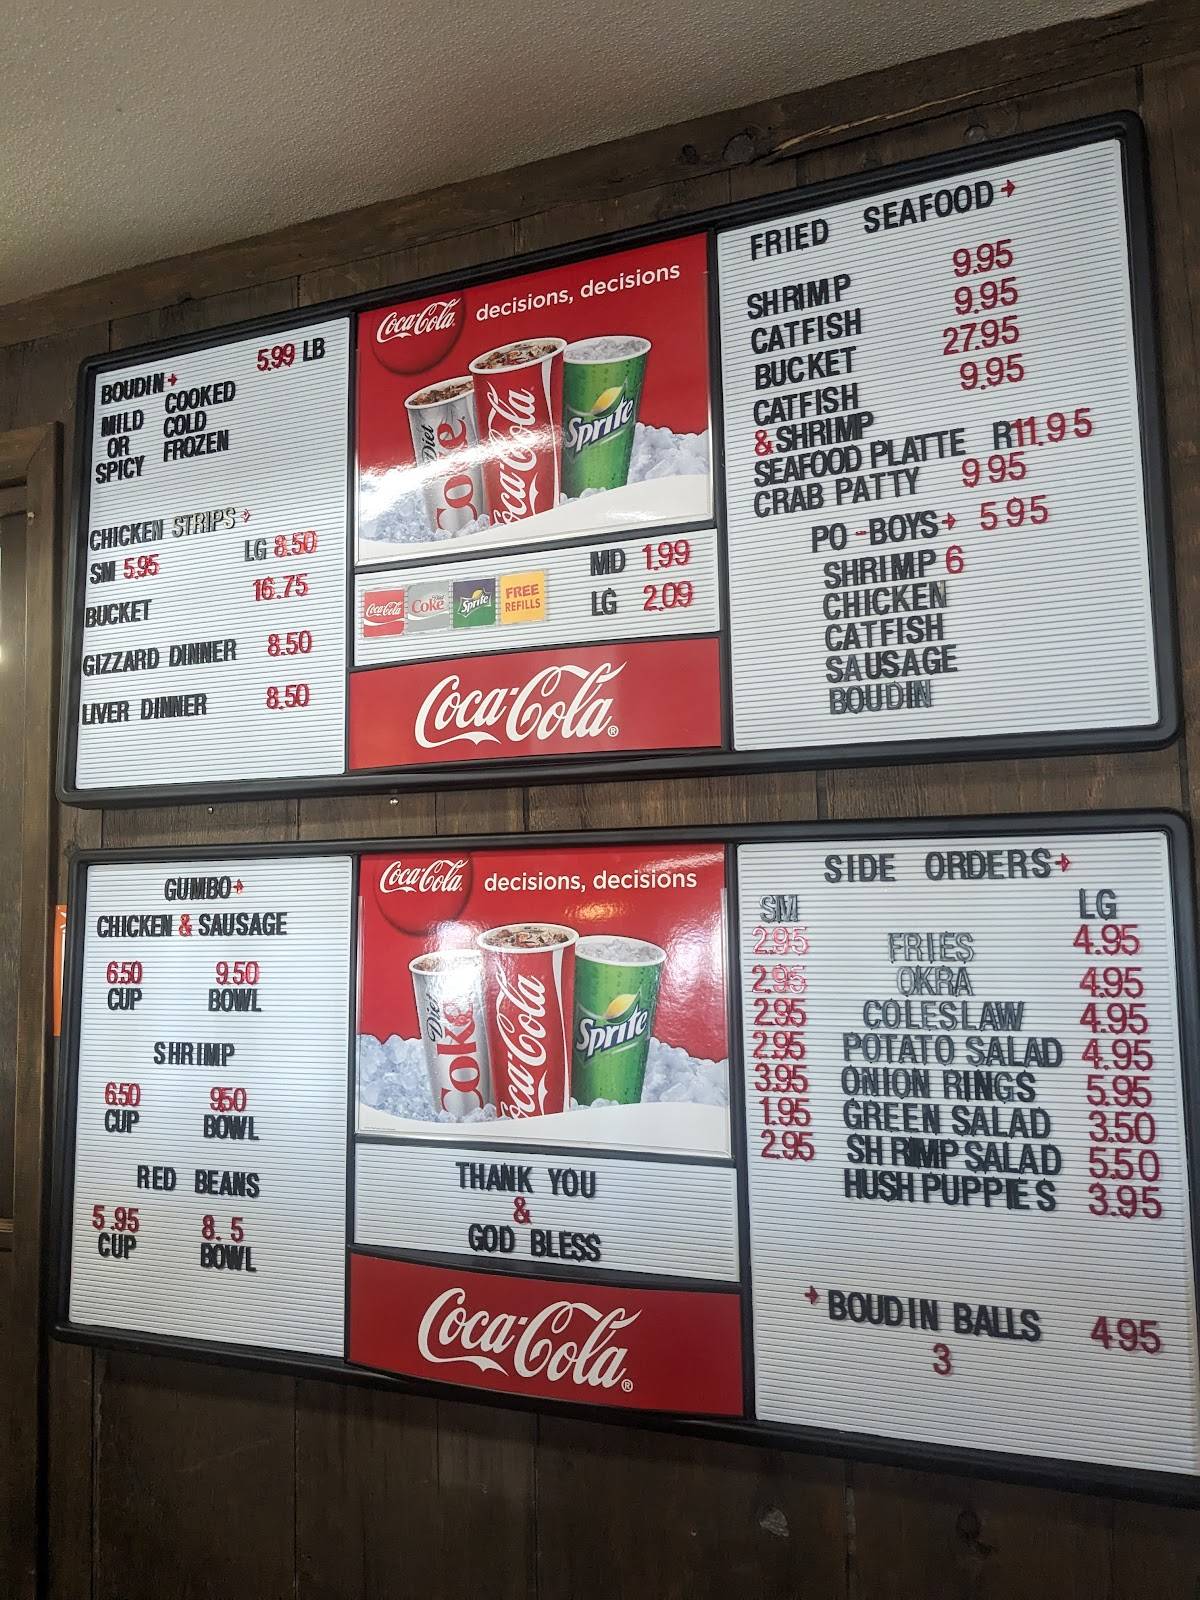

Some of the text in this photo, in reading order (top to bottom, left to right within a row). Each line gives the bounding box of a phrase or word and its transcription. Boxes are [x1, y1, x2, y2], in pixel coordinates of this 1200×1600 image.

[750, 180, 993, 260] FRIED SEAFOOD
[953, 239, 1013, 277] 9.95
[476, 265, 680, 321] decisions, decisions
[747, 273, 851, 320] SHRIMP
[954, 277, 1018, 316] 9.95
[376, 298, 461, 343] Coca-Cola
[751, 308, 861, 354] CATFISH
[942, 315, 1019, 355] 27.95
[257, 337, 325, 371] 5.99 LB
[755, 347, 856, 390] BUCKET
[101, 373, 165, 404] BOUDIN
[959, 353, 1024, 391] 9.95
[165, 381, 236, 413] COOKED
[753, 383, 859, 427] CATFISH
[101, 410, 144, 437] MILD
[164, 411, 206, 438] COLD
[567, 397, 633, 452] Sprite
[107, 436, 130, 459] OR
[164, 430, 229, 462] FROZEN
[96, 456, 145, 483] SPICY
[754, 444, 861, 487] SEAFOOD
[754, 467, 919, 517] CRAB PATTY
[89, 507, 235, 550] CHICKEN STRIPS
[245, 531, 317, 561] LG 8.50
[90, 554, 160, 584] SM 5.95
[590, 540, 690, 576] MD 1.99
[823, 545, 964, 589] SHRIMP 6
[253, 574, 308, 601] 16.75
[462, 594, 489, 613] Sprite
[505, 598, 540, 612] REFILLS
[506, 584, 539, 598] FREE
[592, 581, 693, 616] LG 2.09
[823, 580, 947, 620] CHICKEN
[85, 600, 152, 627] BUCKET
[366, 601, 403, 617] Coca-Cola
[412, 599, 444, 613] Coke
[268, 631, 312, 656] 8.50
[825, 613, 943, 651] CATFISH
[83, 639, 237, 676] GIZZARD DINNER
[825, 645, 958, 683] SAUSAGE
[82, 694, 207, 725] LIVER DINNER
[266, 684, 309, 709] 8.50
[415, 660, 627, 749] Coca-Cola
[829, 679, 934, 714] BOUDIN
[379, 860, 469, 893] Coca-Cola
[484, 870, 697, 892] decisions, decisions
[824, 848, 1051, 883] SIDE ORDERS
[164, 876, 231, 901] GUMBO
[759, 889, 1117, 923] SM LG
[97, 912, 288, 938] CHICKEN & SAUSAGE
[752, 924, 1140, 963] 2.95 FRIES 4.95
[752, 964, 1144, 998] 2.95 OKRA 4.95
[108, 988, 261, 1012] CUP BOWL
[863, 999, 1025, 1031] COLESLAW
[1079, 1002, 1149, 1034] 4.95
[577, 1006, 649, 1060] Sprite
[153, 1042, 235, 1066] SHRIMP
[752, 1031, 1153, 1071] 2.95 POTATO SALAD 4.95
[754, 1064, 1152, 1108] 3.95 ONION RINGS 5.95
[104, 1109, 259, 1140] CUP BOWL
[760, 1097, 1155, 1144] 1.95 GREEN SALAD 3.50
[761, 1129, 814, 1161] 2.95
[964, 1140, 1061, 1176] SALAD
[1089, 1148, 1159, 1181] 5.50
[137, 1165, 260, 1198] RED BEANS
[455, 1162, 596, 1198] THANK YOU
[844, 1169, 914, 1202] HUSH
[1089, 1183, 1162, 1218] 3.95
[513, 1196, 531, 1224] &
[98, 1233, 256, 1272] CUP BOWL
[468, 1223, 601, 1262] GOD BLESS
[828, 1289, 938, 1330] BOUDIN
[954, 1302, 1041, 1342] BALLS
[418, 1288, 642, 1388] Coca-Cola
[933, 1343, 952, 1376] 3
